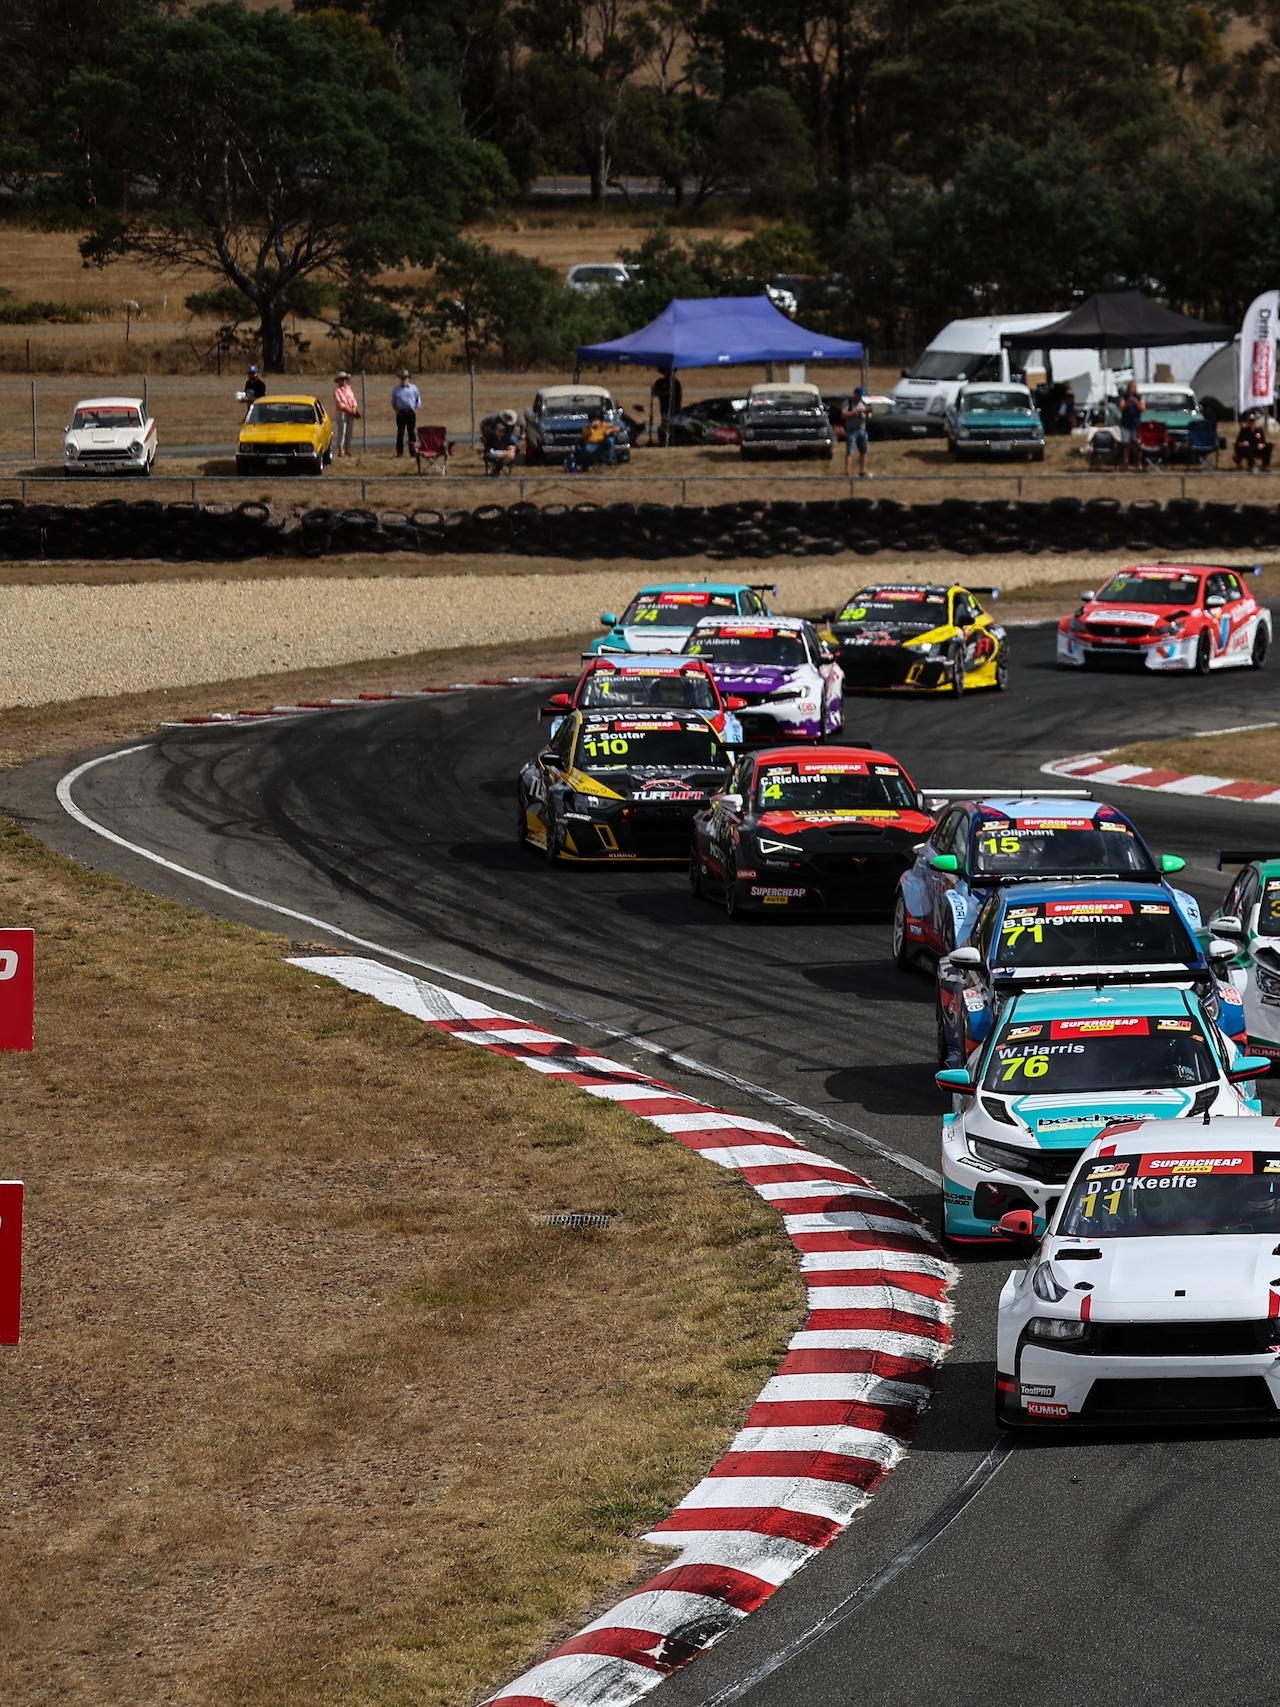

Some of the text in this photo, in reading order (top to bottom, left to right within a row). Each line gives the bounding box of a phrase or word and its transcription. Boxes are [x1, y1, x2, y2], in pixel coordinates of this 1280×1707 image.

[634, 609, 658, 622] 74
[599, 682, 610, 694] 1
[600, 732, 646, 741] Soutar
[584, 740, 629, 757] 110
[760, 774, 828, 786] C.Richards
[763, 784, 783, 800] 4
[983, 837, 1021, 854] 15
[751, 886, 806, 897] SUPERCHEAP
[1054, 904, 1124, 912] SUPERCHEAP
[1003, 915, 1123, 928] B.Bargwanna
[1002, 924, 1043, 946] 71
[1059, 1019, 1139, 1029] SUPERCHEAP
[999, 1043, 1085, 1059] W.Harris
[1001, 1055, 1050, 1081] 76
[1038, 1114, 1135, 1126] beaches
[1149, 1158, 1243, 1168] SUPERCHEAP
[1087, 1175, 1197, 1195] D.O'Keeffe
[1080, 1191, 1121, 1218] 11
[1021, 1385, 1052, 1396] ToolPRO
[1028, 1404, 1068, 1416] KUMHO
